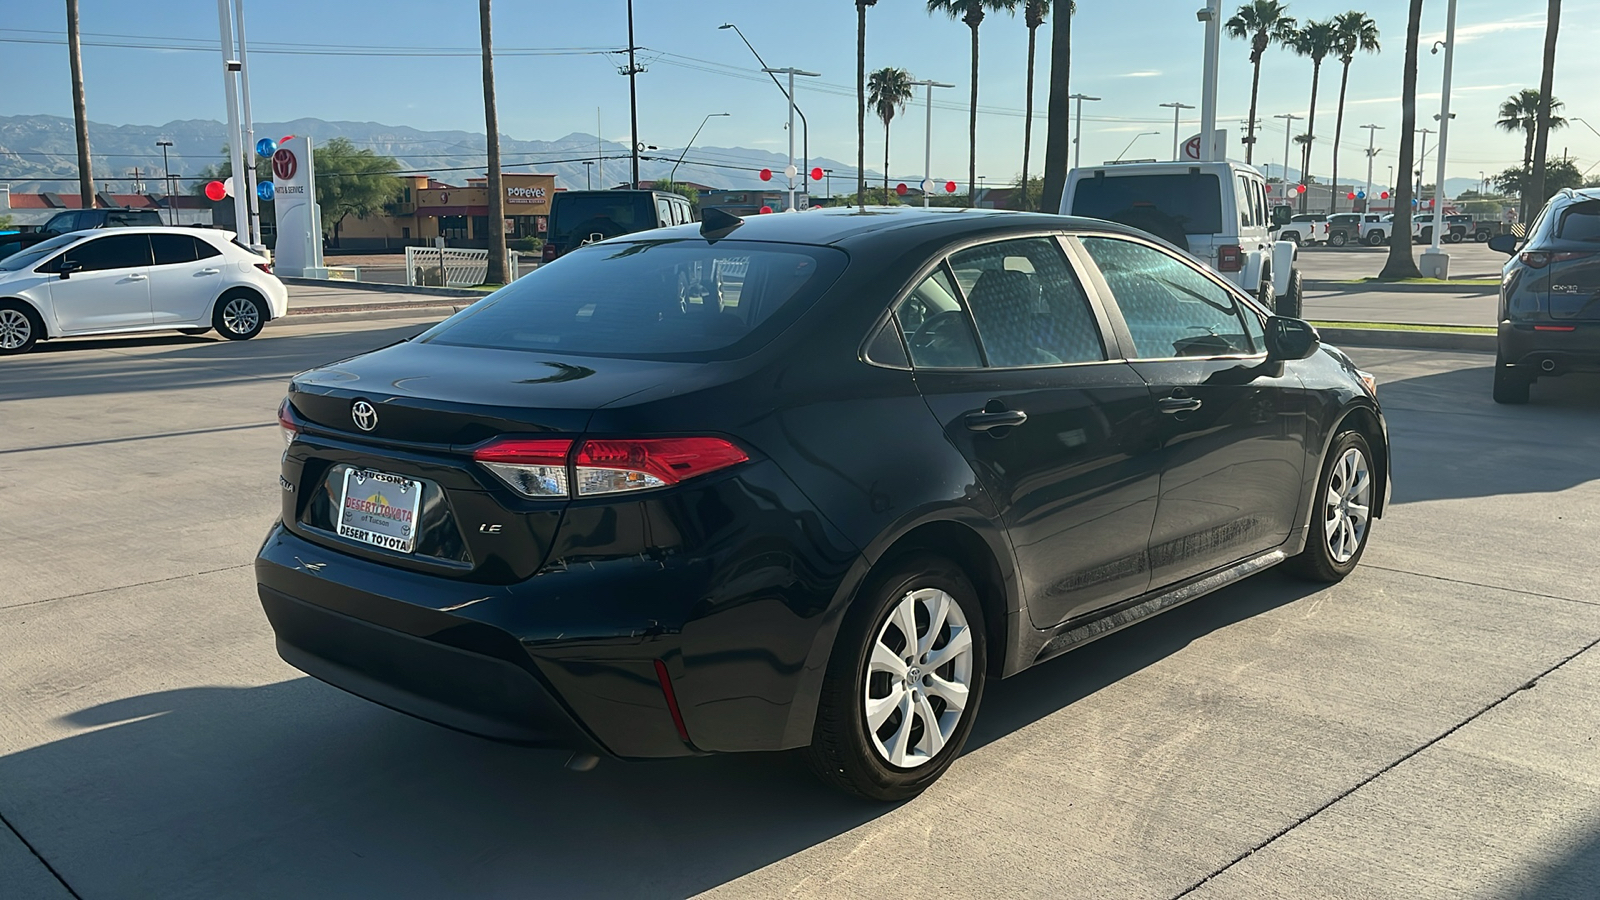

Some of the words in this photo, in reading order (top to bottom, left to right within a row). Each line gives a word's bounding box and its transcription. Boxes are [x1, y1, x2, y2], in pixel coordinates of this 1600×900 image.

[364, 472, 400, 484] TUCSON
[345, 497, 377, 515] DESERT
[379, 504, 412, 523] TOYOTA
[369, 516, 390, 528] Tucson
[479, 523, 503, 535] LE
[340, 526, 370, 541] DESERT
[372, 533, 407, 551] TOYOTA
